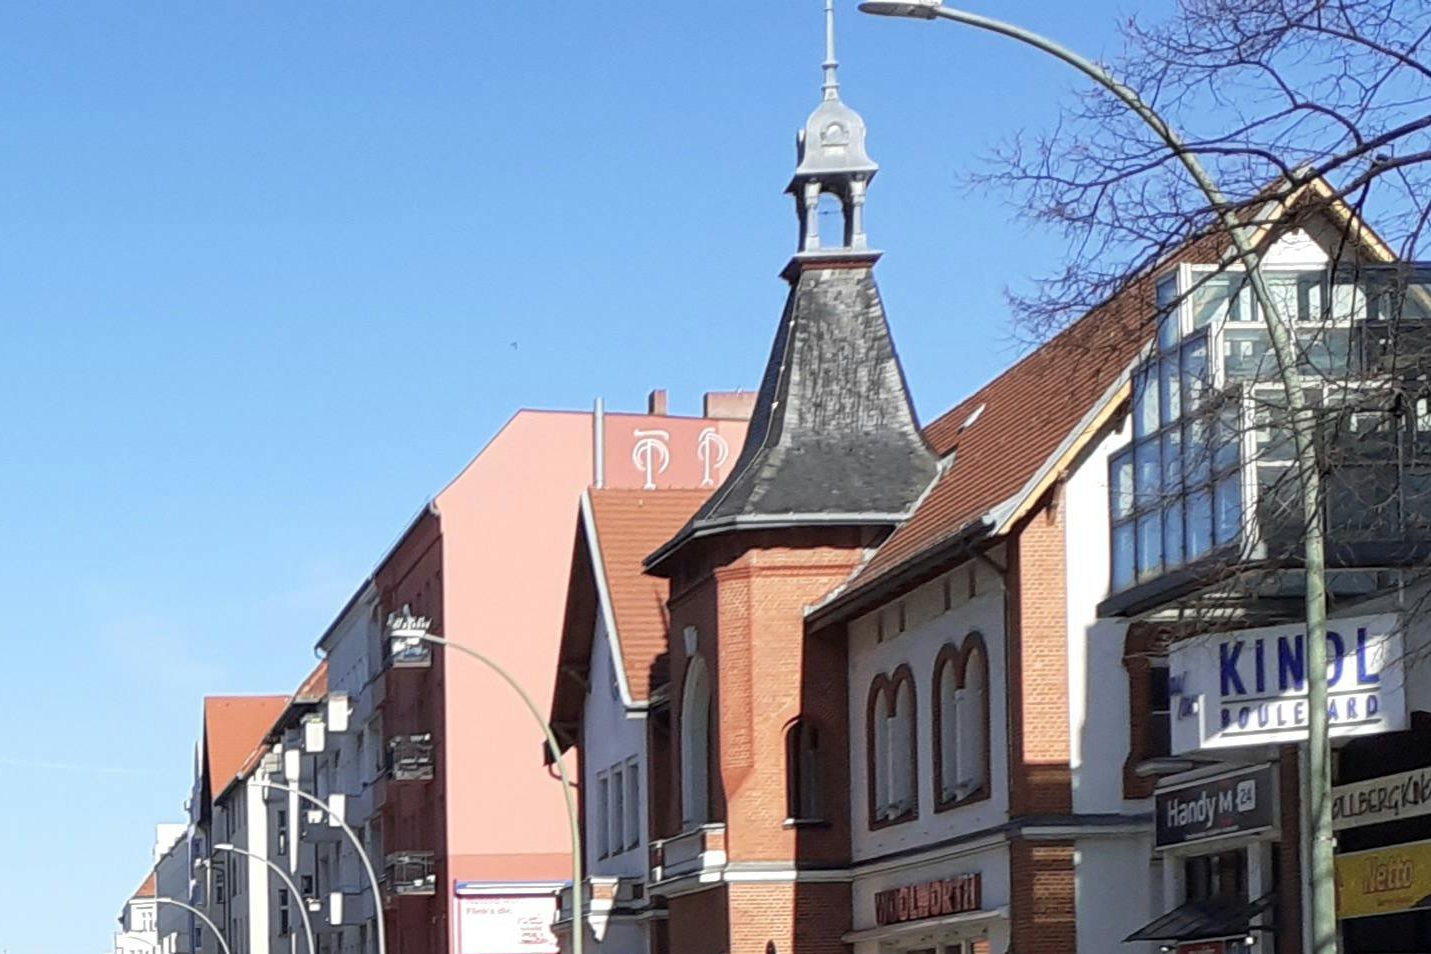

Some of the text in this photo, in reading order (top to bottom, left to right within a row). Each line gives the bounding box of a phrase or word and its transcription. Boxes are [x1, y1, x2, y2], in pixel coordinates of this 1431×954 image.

[1220, 627, 1381, 697] KINDL
[1221, 693, 1379, 730] BOULEARD
[1168, 790, 1217, 829] Handy
[1363, 855, 1416, 895] Netto
